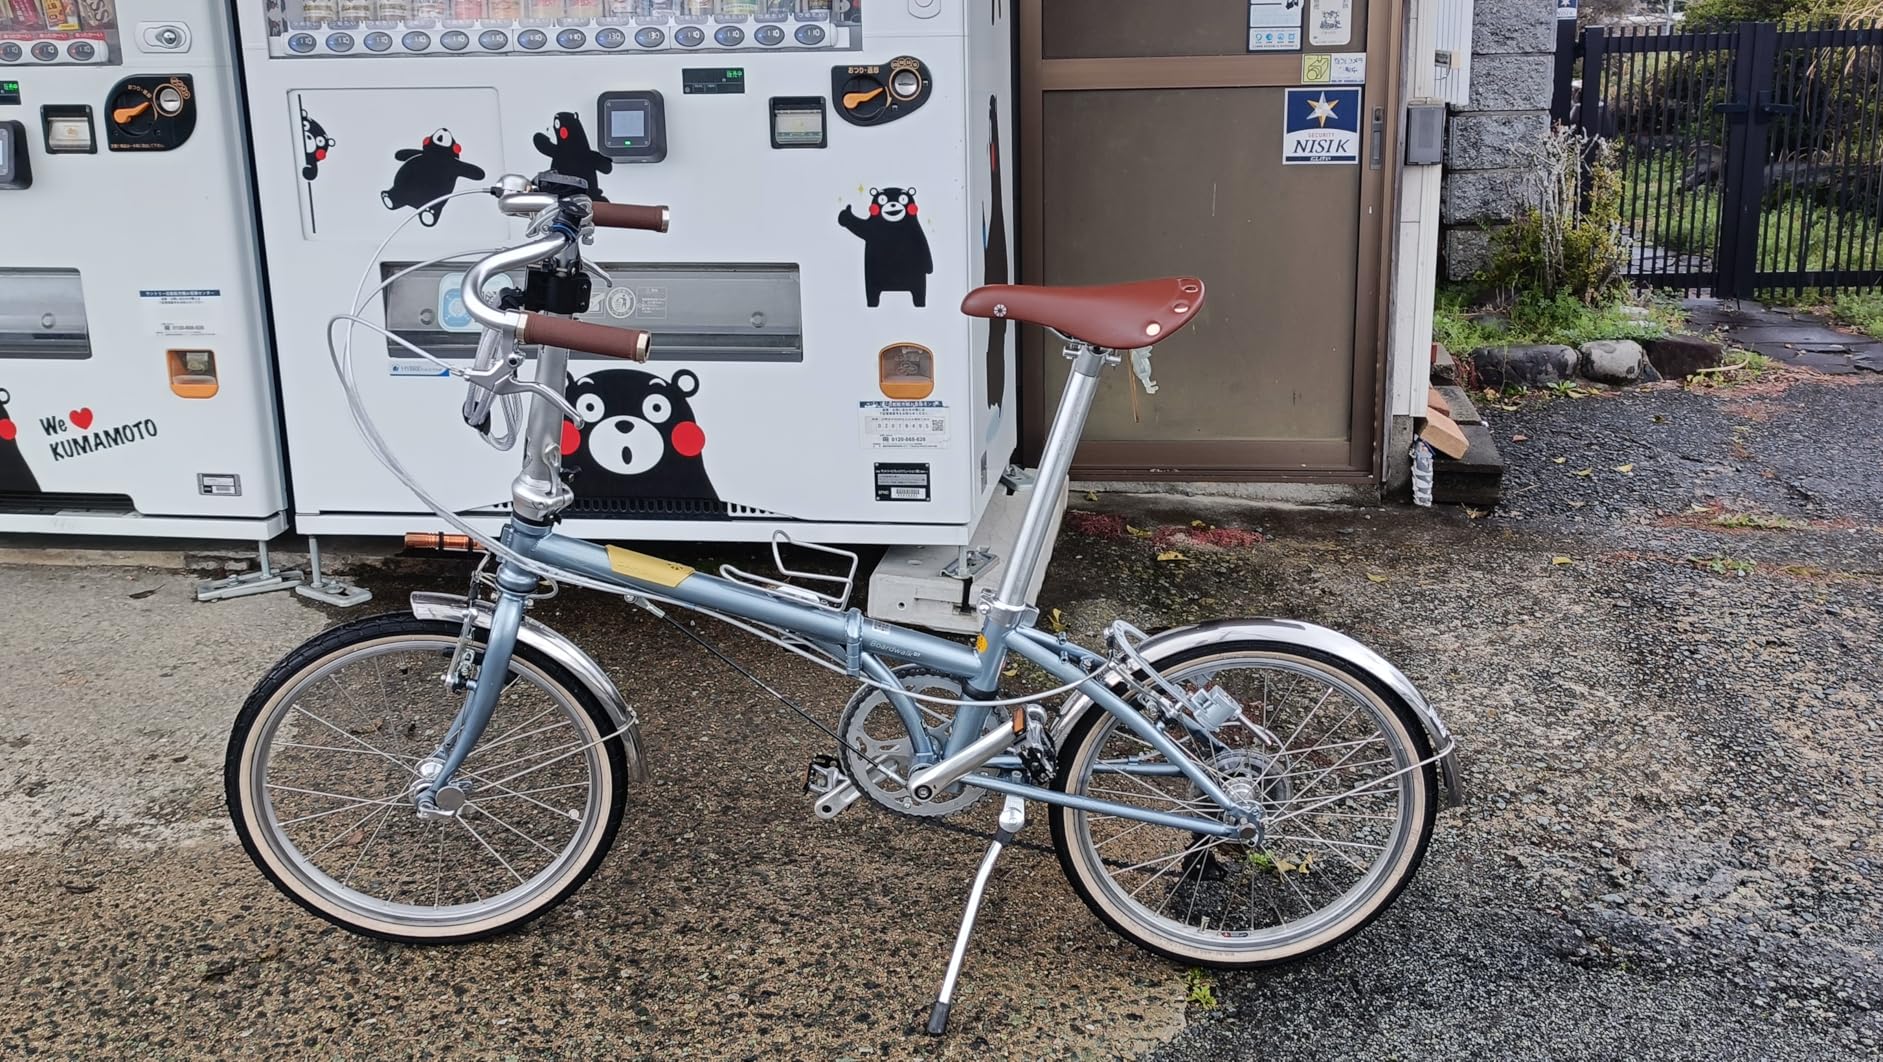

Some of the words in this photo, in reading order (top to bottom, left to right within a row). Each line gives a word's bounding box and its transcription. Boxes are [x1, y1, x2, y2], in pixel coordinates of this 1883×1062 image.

[608, 32, 621, 41] 130
[807, 28, 821, 37] 110
[39, 415, 68, 436] We
[49, 418, 157, 461] KUMAMOTO
[870, 640, 913, 657] Boardwalk
